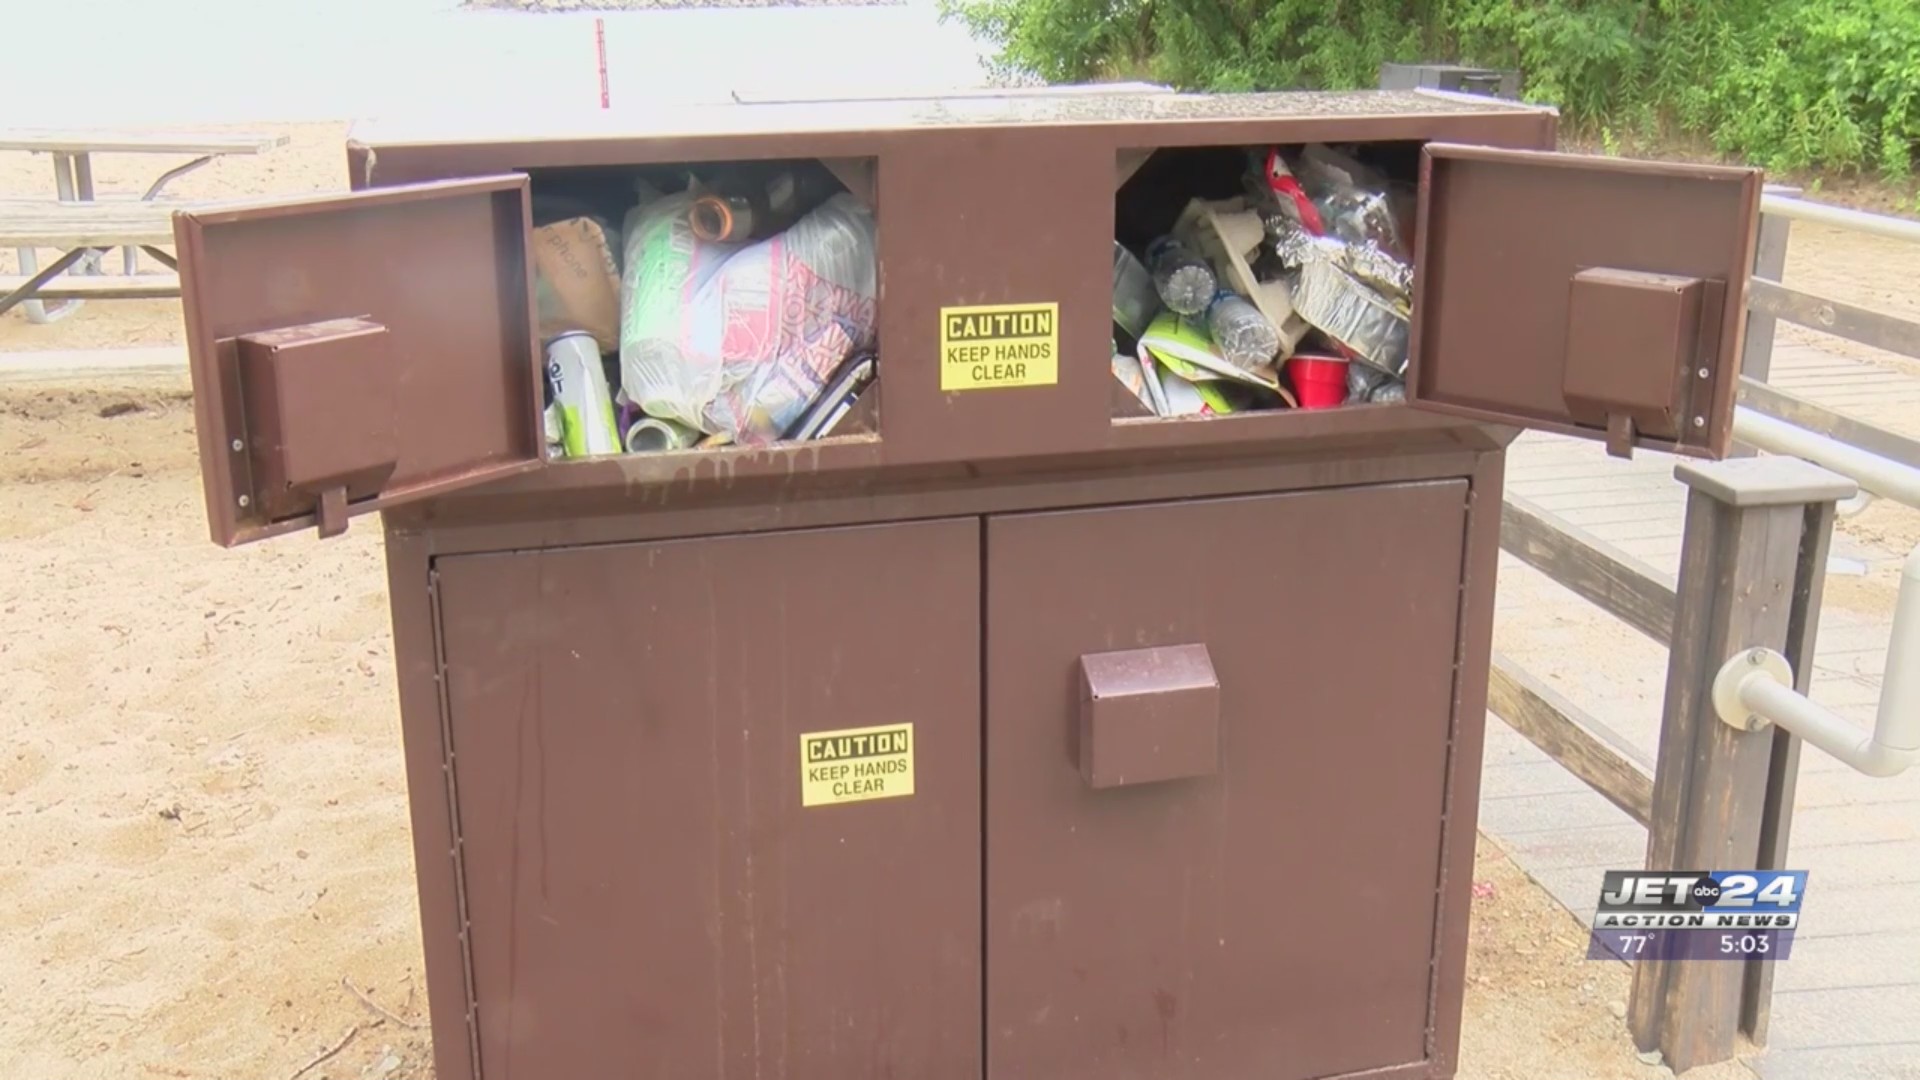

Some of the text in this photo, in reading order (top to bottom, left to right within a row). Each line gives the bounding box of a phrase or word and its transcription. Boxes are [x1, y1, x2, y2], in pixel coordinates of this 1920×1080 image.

[948, 312, 1051, 338] CAUTION
[947, 343, 1051, 363] KEEP HANDS
[972, 363, 1026, 381] CLEAR
[809, 732, 907, 760] CAUTION
[809, 759, 907, 782] KEEP HANDS
[832, 778, 885, 796] CLEAR
